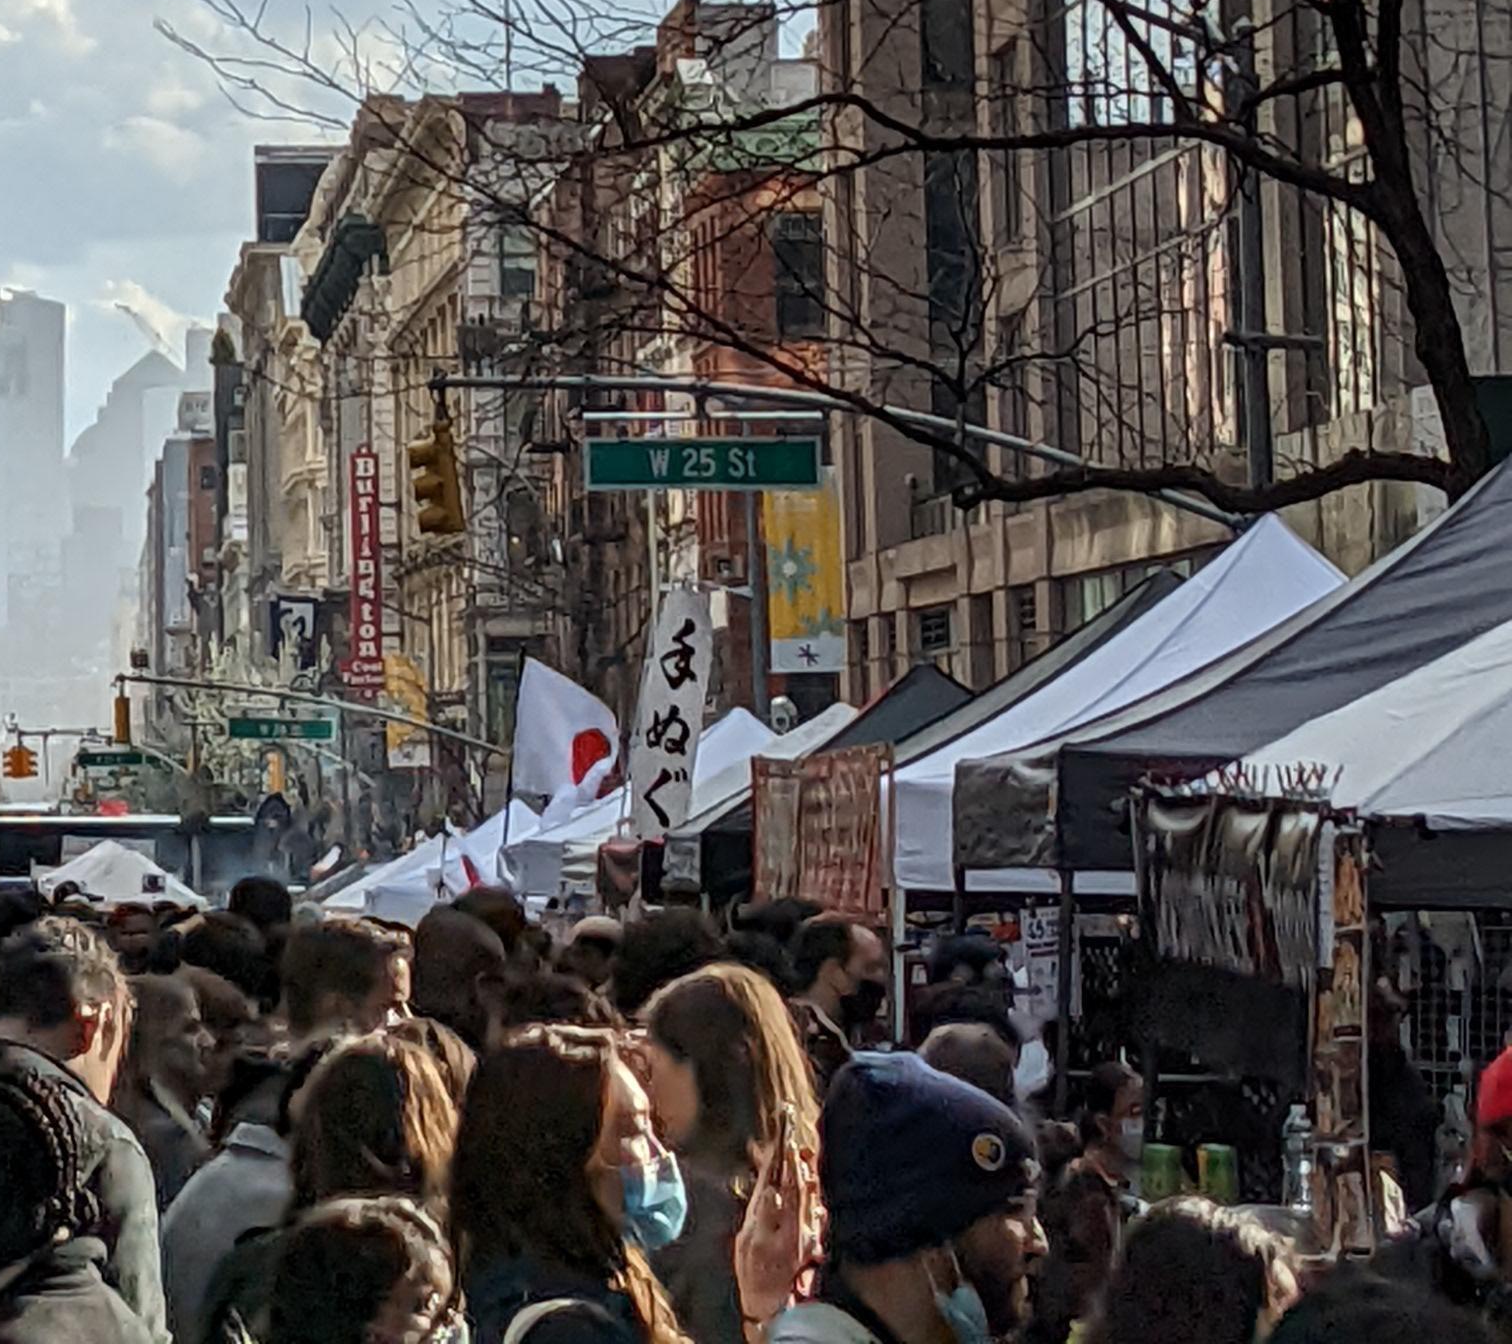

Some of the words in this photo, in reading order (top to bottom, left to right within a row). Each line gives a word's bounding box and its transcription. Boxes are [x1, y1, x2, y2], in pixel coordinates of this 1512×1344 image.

[648, 449, 670, 478] W
[681, 447, 716, 478] 25
[727, 447, 757, 478] St
[354, 456, 378, 658] Burlington
